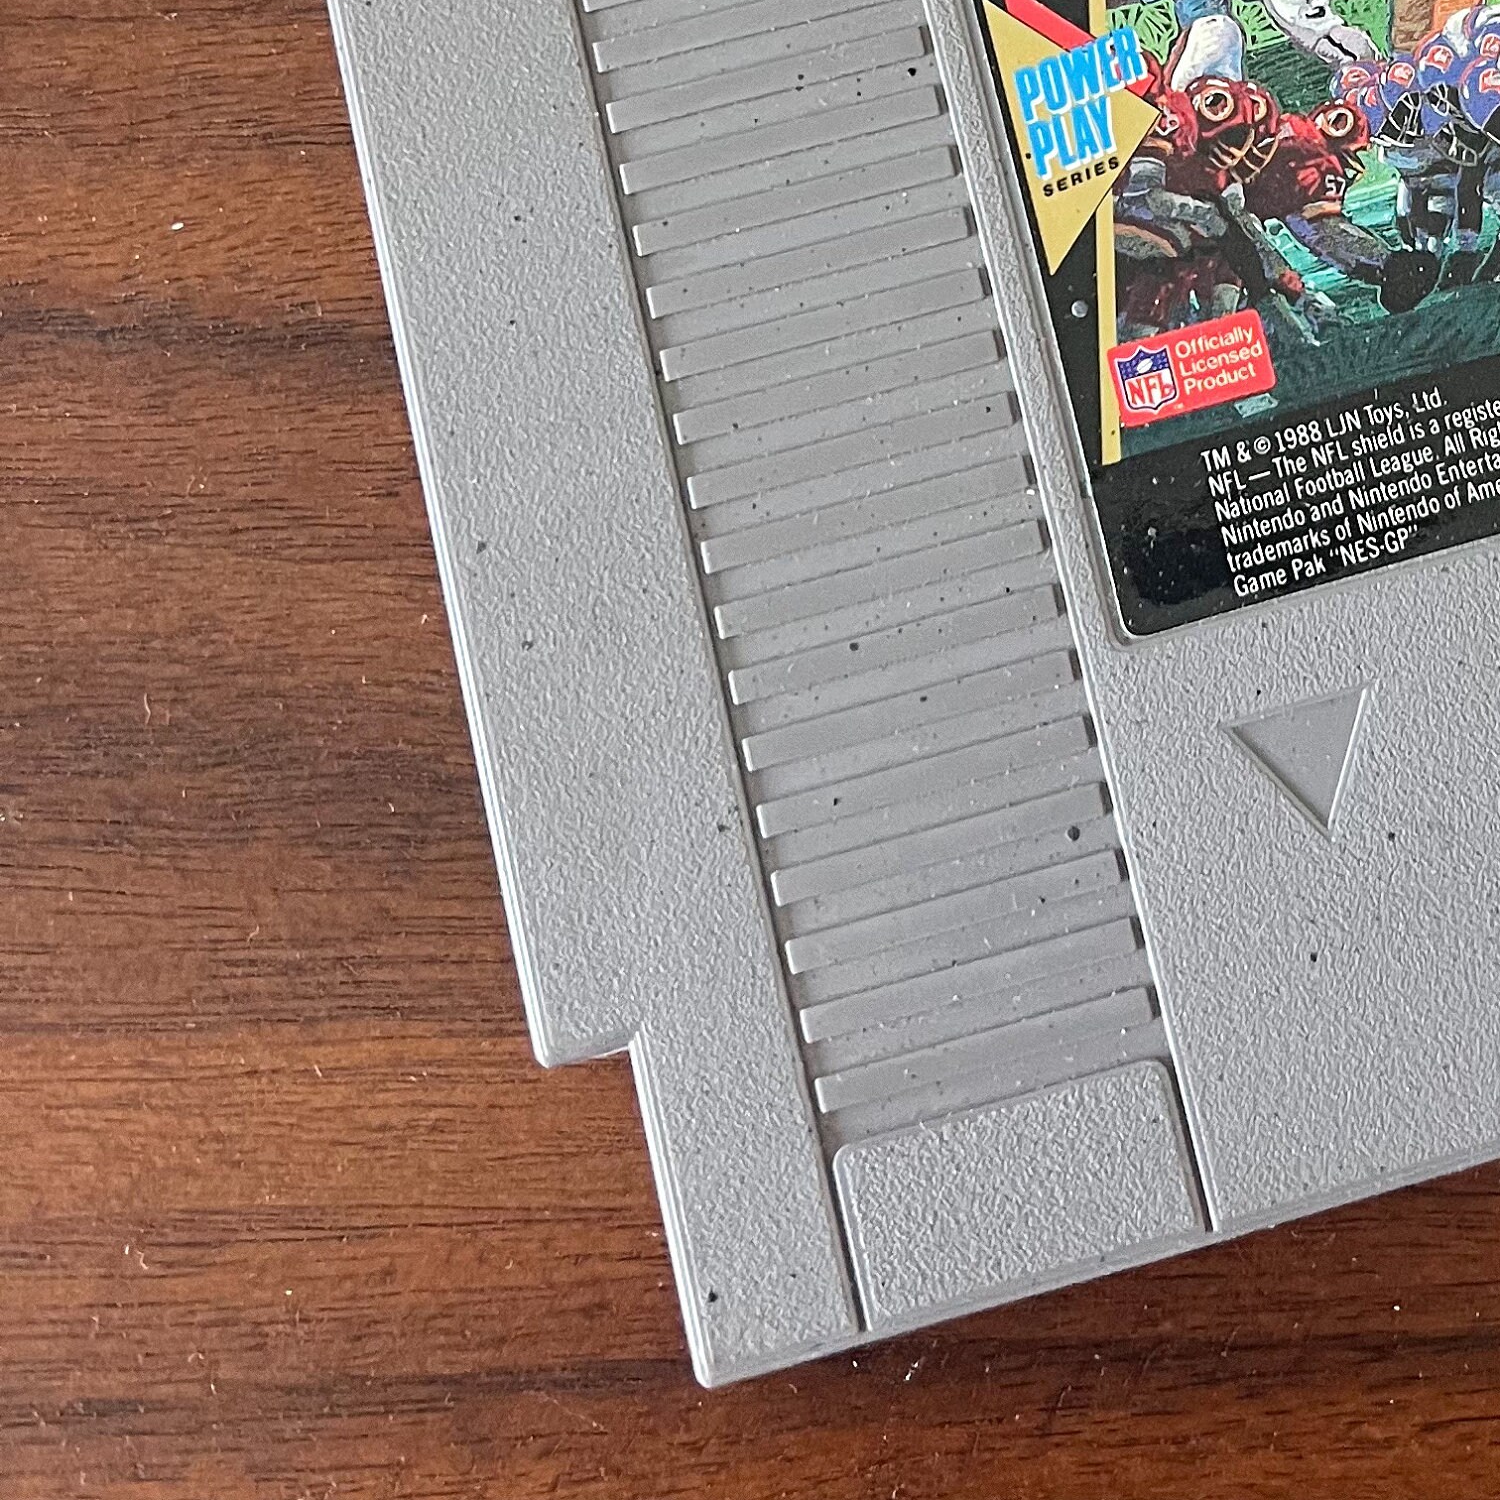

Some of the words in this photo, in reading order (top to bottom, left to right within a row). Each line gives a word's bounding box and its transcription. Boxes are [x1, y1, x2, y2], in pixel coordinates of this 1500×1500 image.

[1014, 26, 1148, 123] POWER
[1026, 94, 1118, 180] PLAY
[1042, 156, 1120, 197] SERIES
[1175, 326, 1253, 359] Officially
[1179, 341, 1263, 377] Licensed
[1127, 372, 1174, 406] NFL
[1184, 362, 1257, 395] Product
[1200, 445, 1231, 471] TM
[1237, 442, 1251, 463] &
[1275, 419, 1323, 452] 1988
[1325, 409, 1362, 438] LJN
[1363, 402, 1410, 426] Toys,
[1412, 386, 1447, 413] Ltd.
[1311, 441, 1349, 468] NFL
[1353, 424, 1405, 457] shield
[1409, 421, 1425, 440] is
[1429, 419, 1441, 434] a
[1214, 483, 1290, 522] National
[1294, 461, 1366, 499] Football
[1369, 444, 1439, 478] League.
[1444, 433, 1465, 457] All
[1221, 508, 1306, 548] Nintendo
[1310, 497, 1344, 522] and
[1349, 472, 1433, 510] Nintendo
[1227, 527, 1331, 573] trademarks
[1335, 517, 1352, 541] of
[1356, 496, 1440, 534] Nintendo
[1445, 486, 1462, 510] of
[1234, 568, 1287, 597] Game
[1292, 554, 1326, 581] Pak
